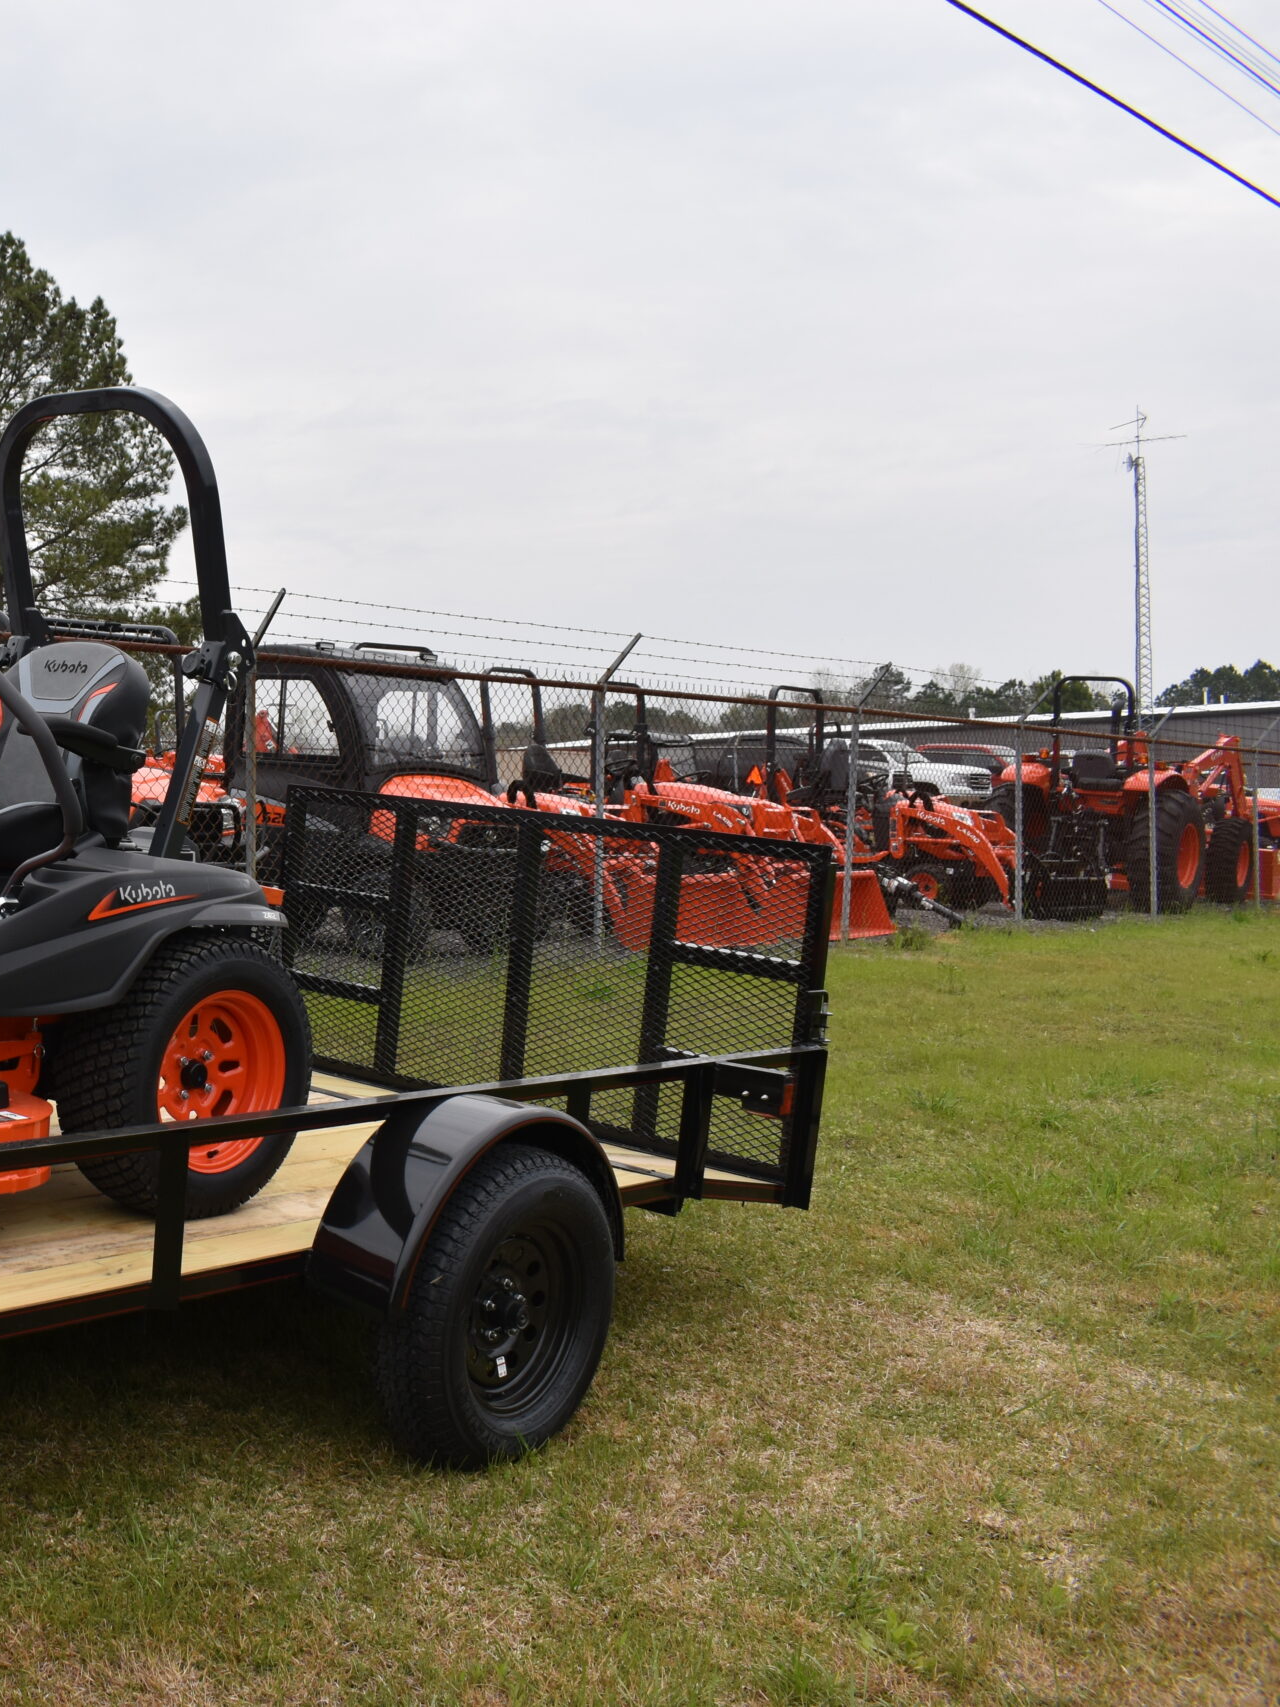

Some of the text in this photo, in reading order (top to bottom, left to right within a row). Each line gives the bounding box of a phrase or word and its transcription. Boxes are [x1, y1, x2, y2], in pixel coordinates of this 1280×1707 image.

[44, 659, 88, 673] Kubota
[667, 800, 700, 815] Kubota
[916, 811, 946, 825] Kubota
[119, 880, 176, 903] Kubota
